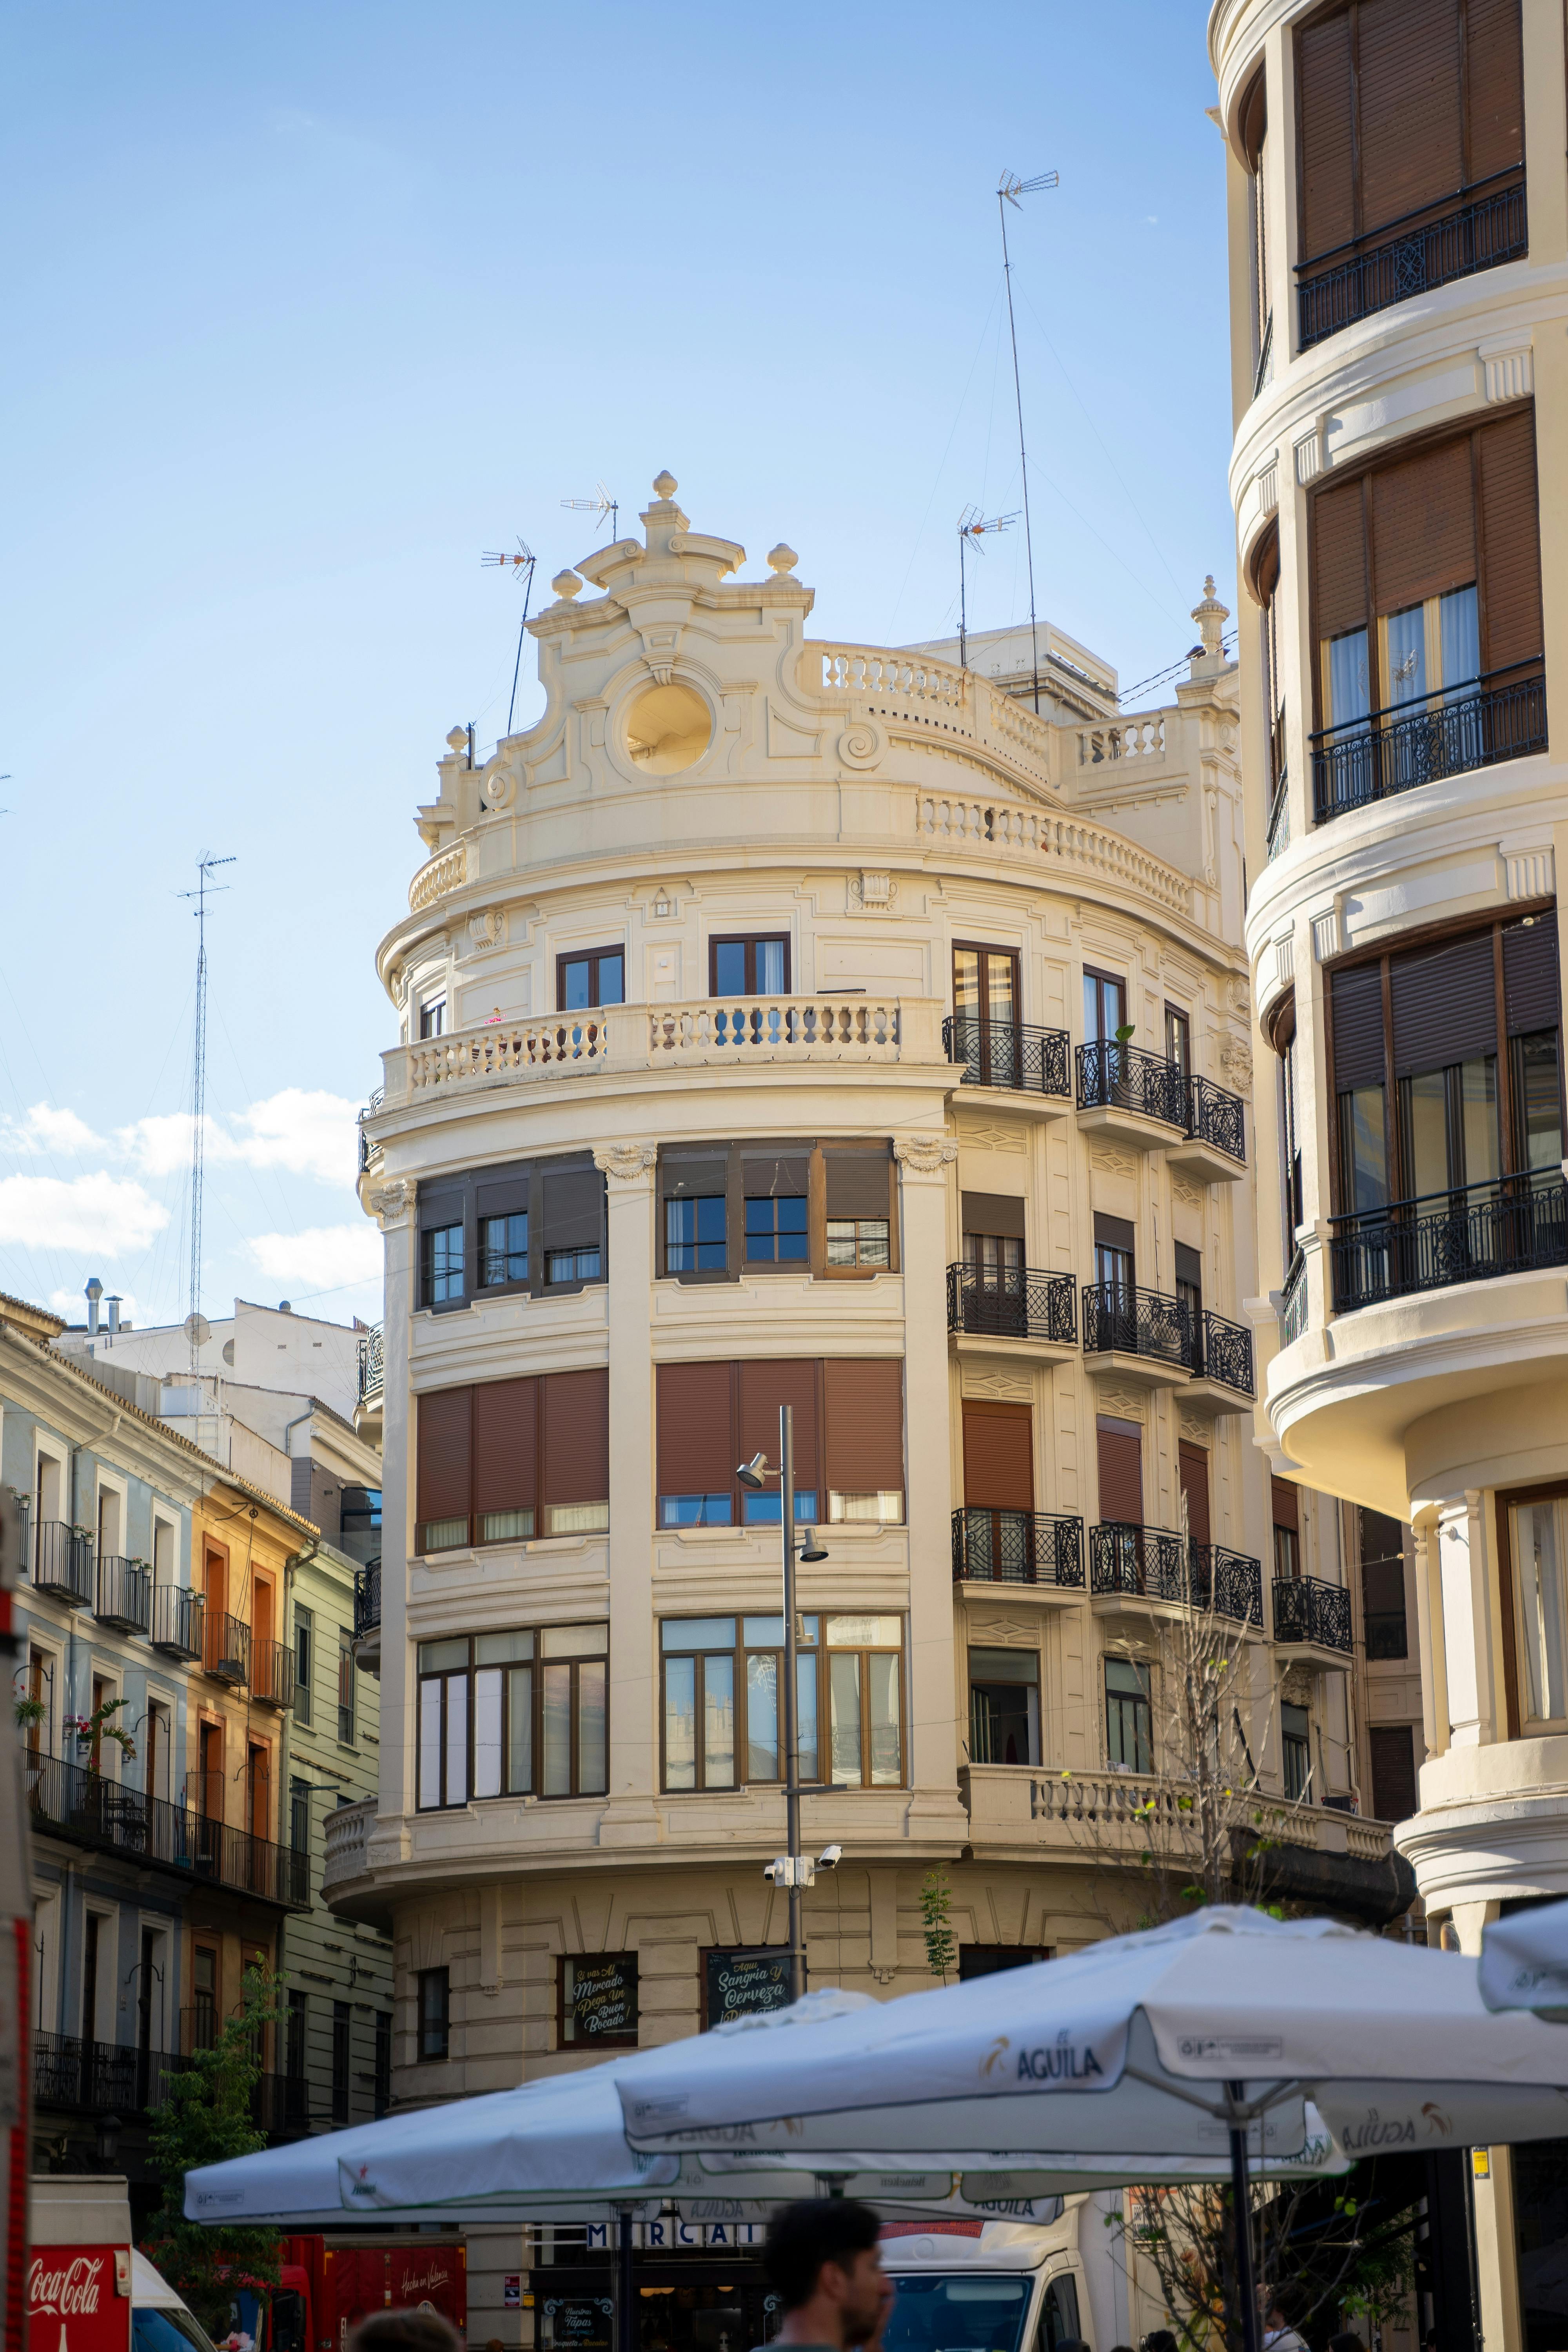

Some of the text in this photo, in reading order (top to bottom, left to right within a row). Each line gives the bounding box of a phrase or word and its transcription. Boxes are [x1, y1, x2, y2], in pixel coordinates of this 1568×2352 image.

[577, 1964, 615, 1982] Si vas Al
[770, 1966, 782, 1981] Y
[573, 1974, 624, 2000] Mercado
[609, 1989, 625, 2001] Un
[725, 1984, 785, 2008] Cerveza
[598, 2002, 625, 2018] Buen
[588, 2222, 757, 2247] MRCAT
[26, 2258, 105, 2315] Coca-Cola
[401, 2261, 448, 2299] Hecha en Valencia
[564, 2316, 593, 2329] Tapas
[582, 2338, 608, 2347] Bacalao
